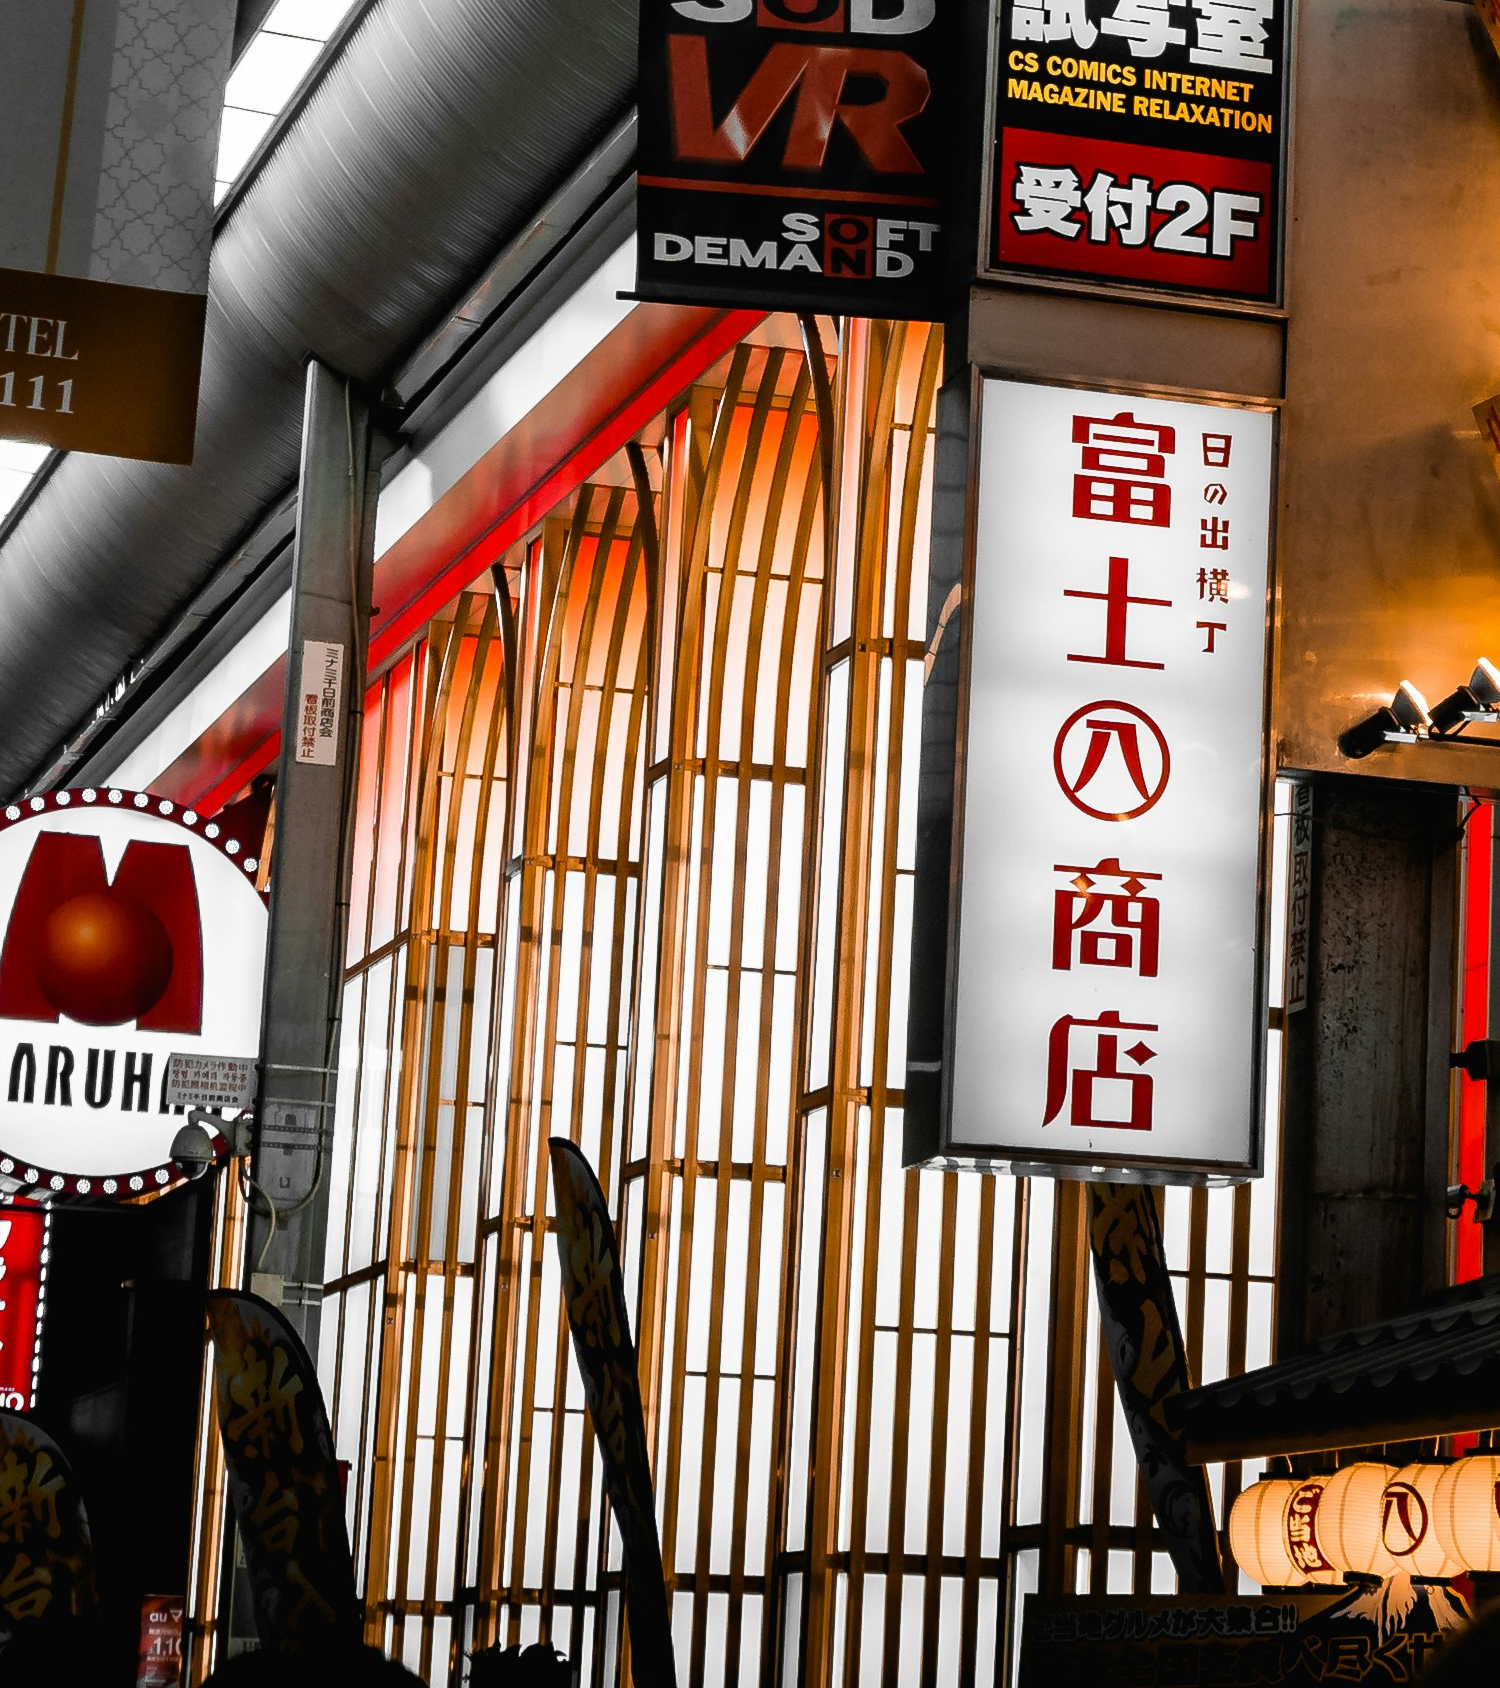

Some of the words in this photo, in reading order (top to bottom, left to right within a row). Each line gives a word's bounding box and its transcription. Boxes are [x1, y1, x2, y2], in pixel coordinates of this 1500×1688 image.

[667, 34, 932, 176] VR
[1007, 77, 1127, 115] MAGAZINE
[1132, 93, 1274, 135] RELAXATION
[1008, 49, 1038, 73] CS
[1046, 56, 1138, 87] COMICS
[1144, 68, 1255, 103] INTERNET
[1012, 162, 1261, 261] 受付2F
[1194, 432, 1233, 654] 日の出横丁
[300, 693, 318, 759] 看板取付禁止
[319, 647, 338, 738] ミナミ千日前商店会
